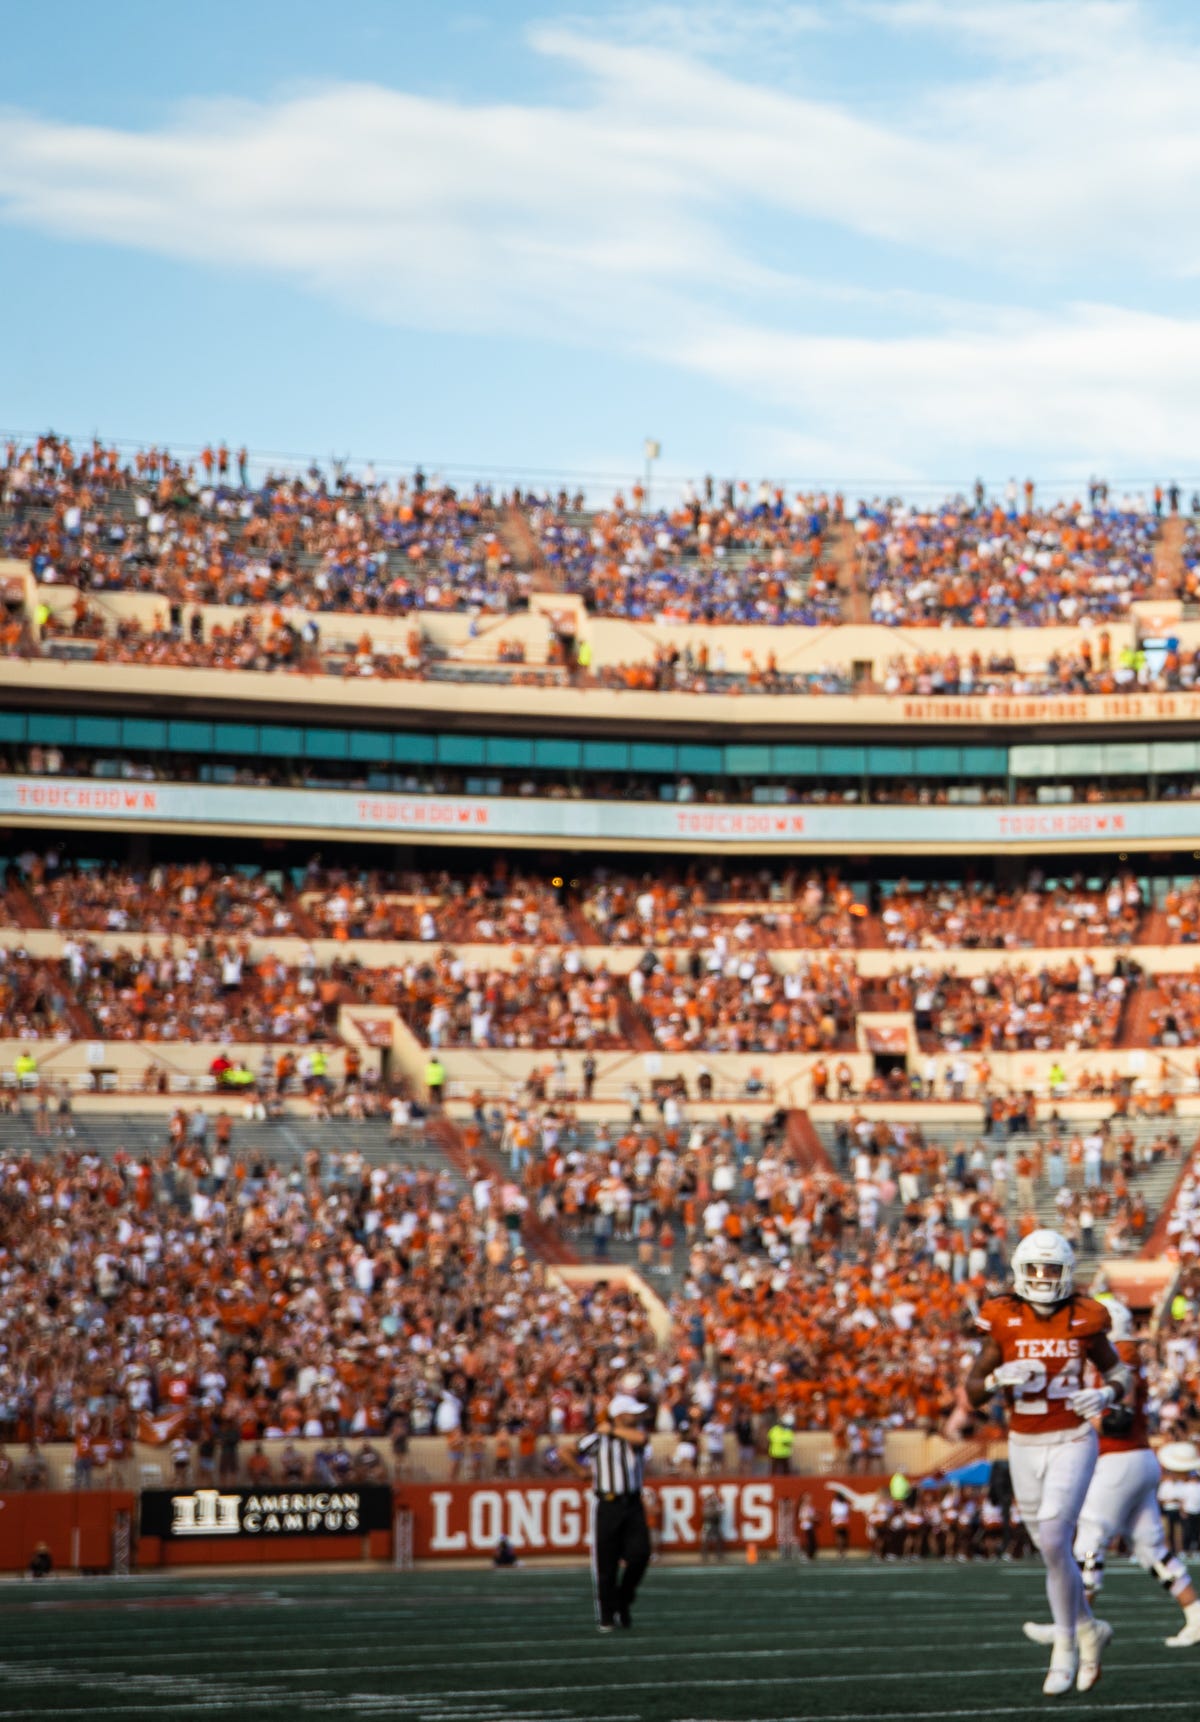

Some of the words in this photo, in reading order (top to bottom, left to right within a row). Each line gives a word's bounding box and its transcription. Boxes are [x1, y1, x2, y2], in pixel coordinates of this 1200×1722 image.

[16, 783, 157, 811] TOUCHDOWN
[357, 799, 489, 826] TOUCHDOWN
[676, 811, 805, 834] TOUCHDOWN
[996, 813, 1126, 835] TOUCHDOWN
[1014, 1339, 1080, 1358] TEXAS
[1012, 1358, 1083, 1415] 24
[244, 1493, 360, 1513] AMERICAN
[242, 1511, 360, 1533] CAMPUS
[429, 1483, 774, 1550] LONGRNS
